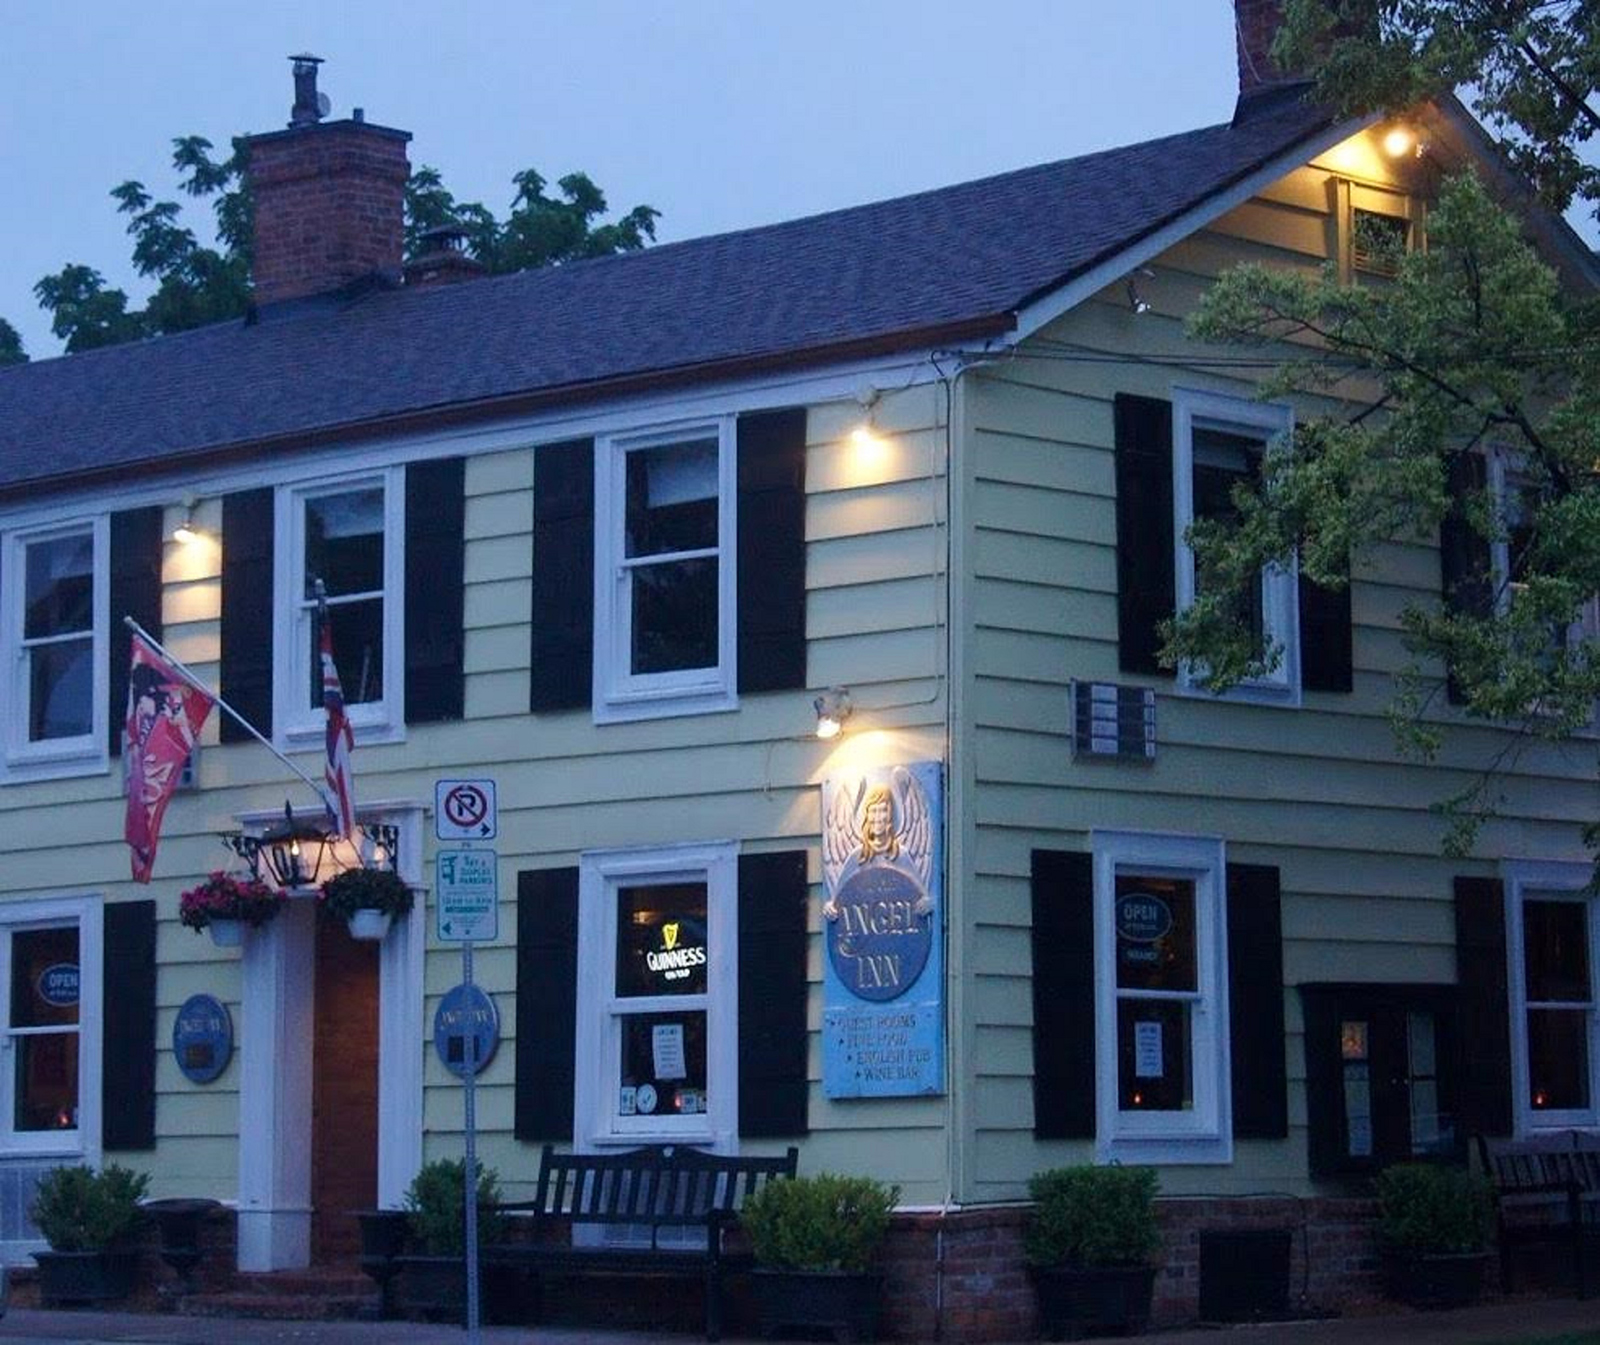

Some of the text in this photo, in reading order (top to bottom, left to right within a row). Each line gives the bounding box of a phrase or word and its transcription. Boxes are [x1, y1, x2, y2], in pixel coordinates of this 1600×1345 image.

[838, 901, 919, 935] ANGEL
[1124, 903, 1157, 920] OPEN
[646, 947, 706, 971] GUINNESS
[50, 973, 79, 987] OPEN
[859, 955, 899, 988] INN
[877, 1013, 916, 1030] ROOMS
[857, 1047, 930, 1065] ENGLISH PUB
[863, 1065, 919, 1081] WINE BAR
